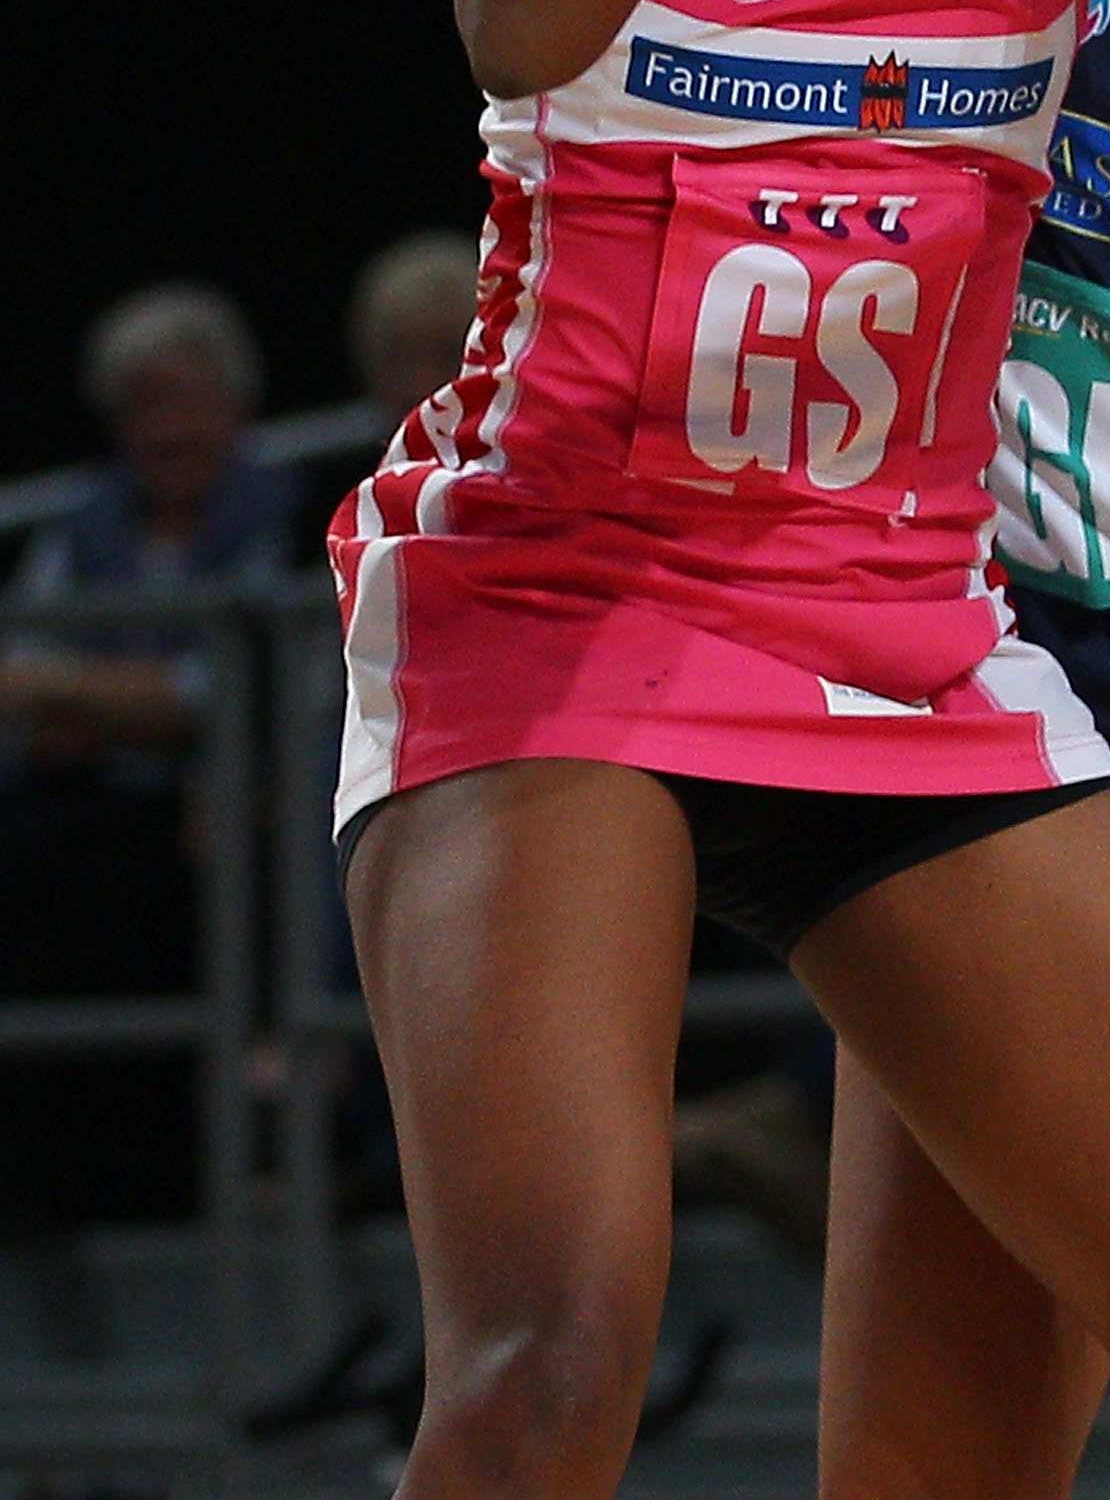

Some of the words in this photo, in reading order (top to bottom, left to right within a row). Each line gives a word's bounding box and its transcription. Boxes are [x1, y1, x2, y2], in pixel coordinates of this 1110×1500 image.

[645, 50, 849, 115] Fairmont
[918, 77, 1042, 117] Homes
[1012, 293, 1072, 332] ACV
[686, 243, 920, 490] GS
